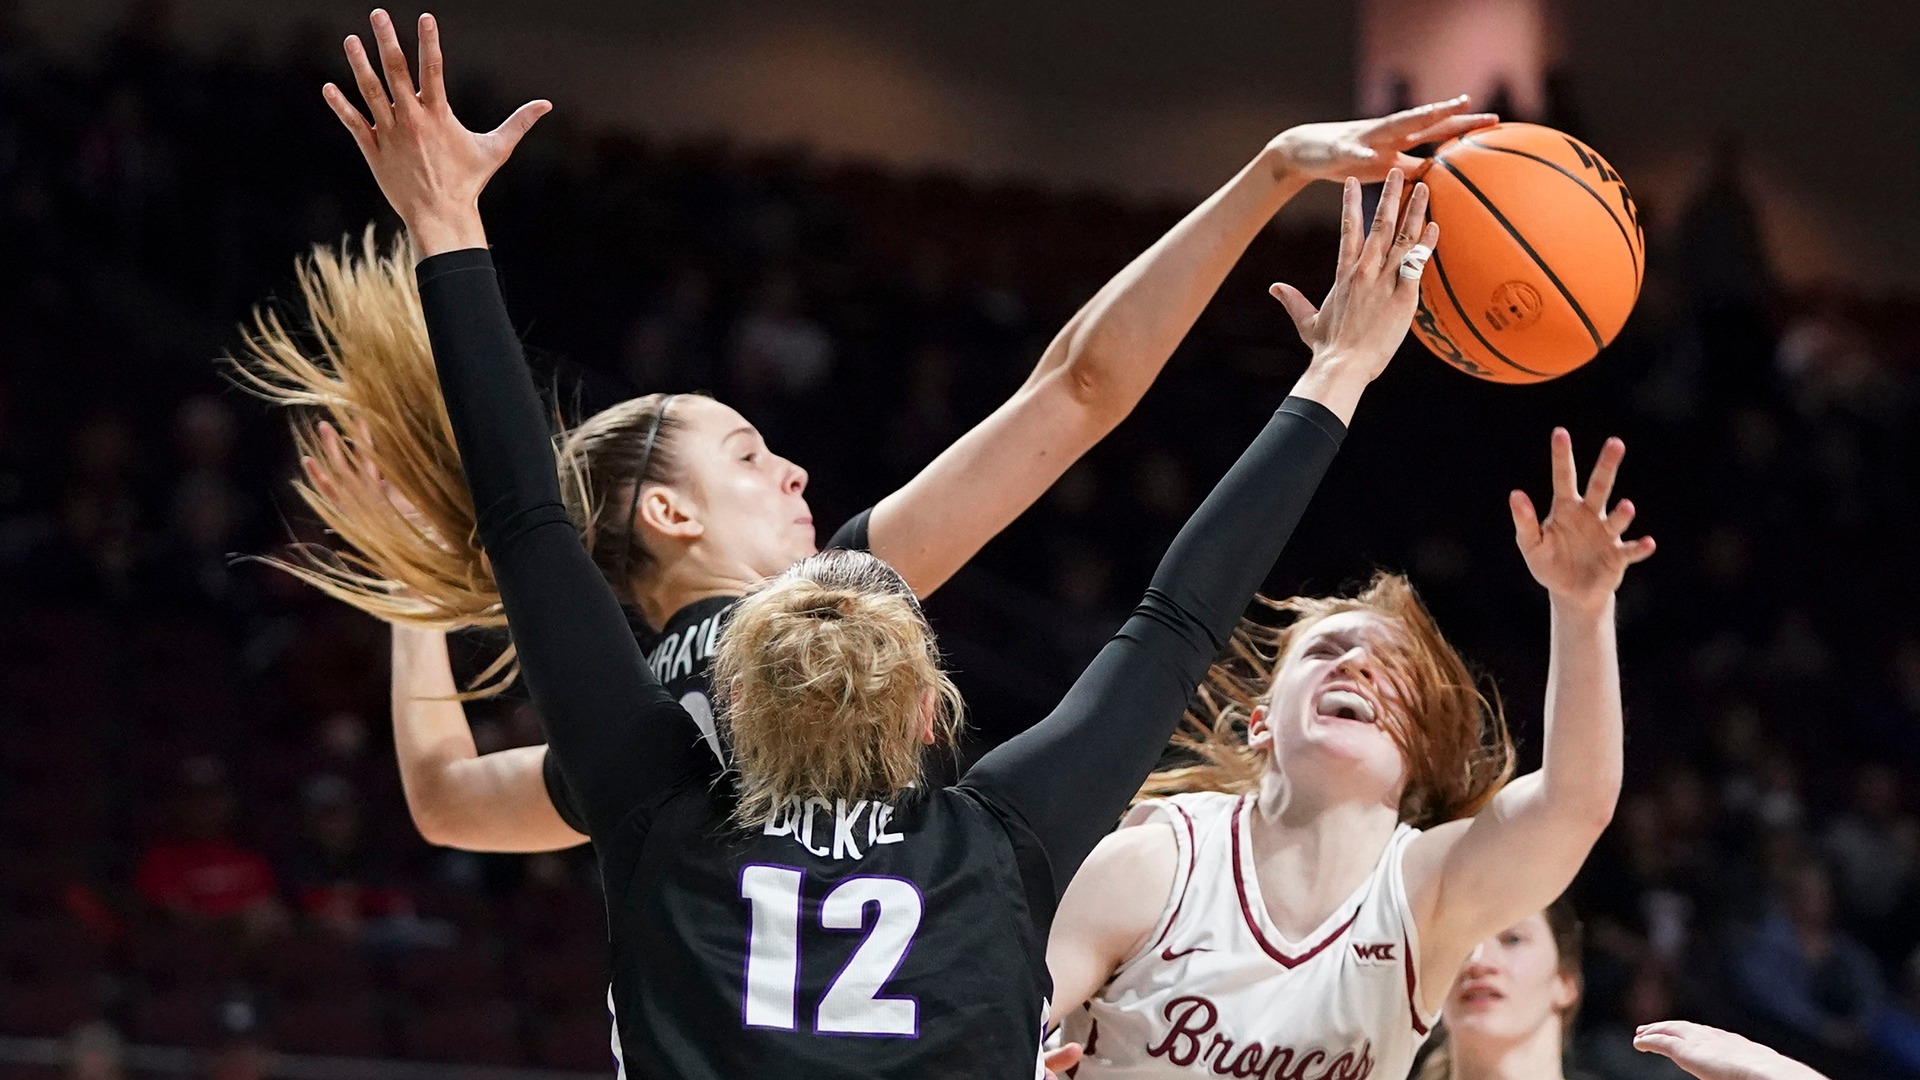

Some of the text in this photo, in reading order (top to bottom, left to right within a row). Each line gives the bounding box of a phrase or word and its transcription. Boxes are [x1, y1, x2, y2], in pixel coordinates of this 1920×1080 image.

[739, 863, 925, 1039] 12
[1352, 944, 1397, 961] WCC
[1146, 995, 1375, 1080] Broncos
